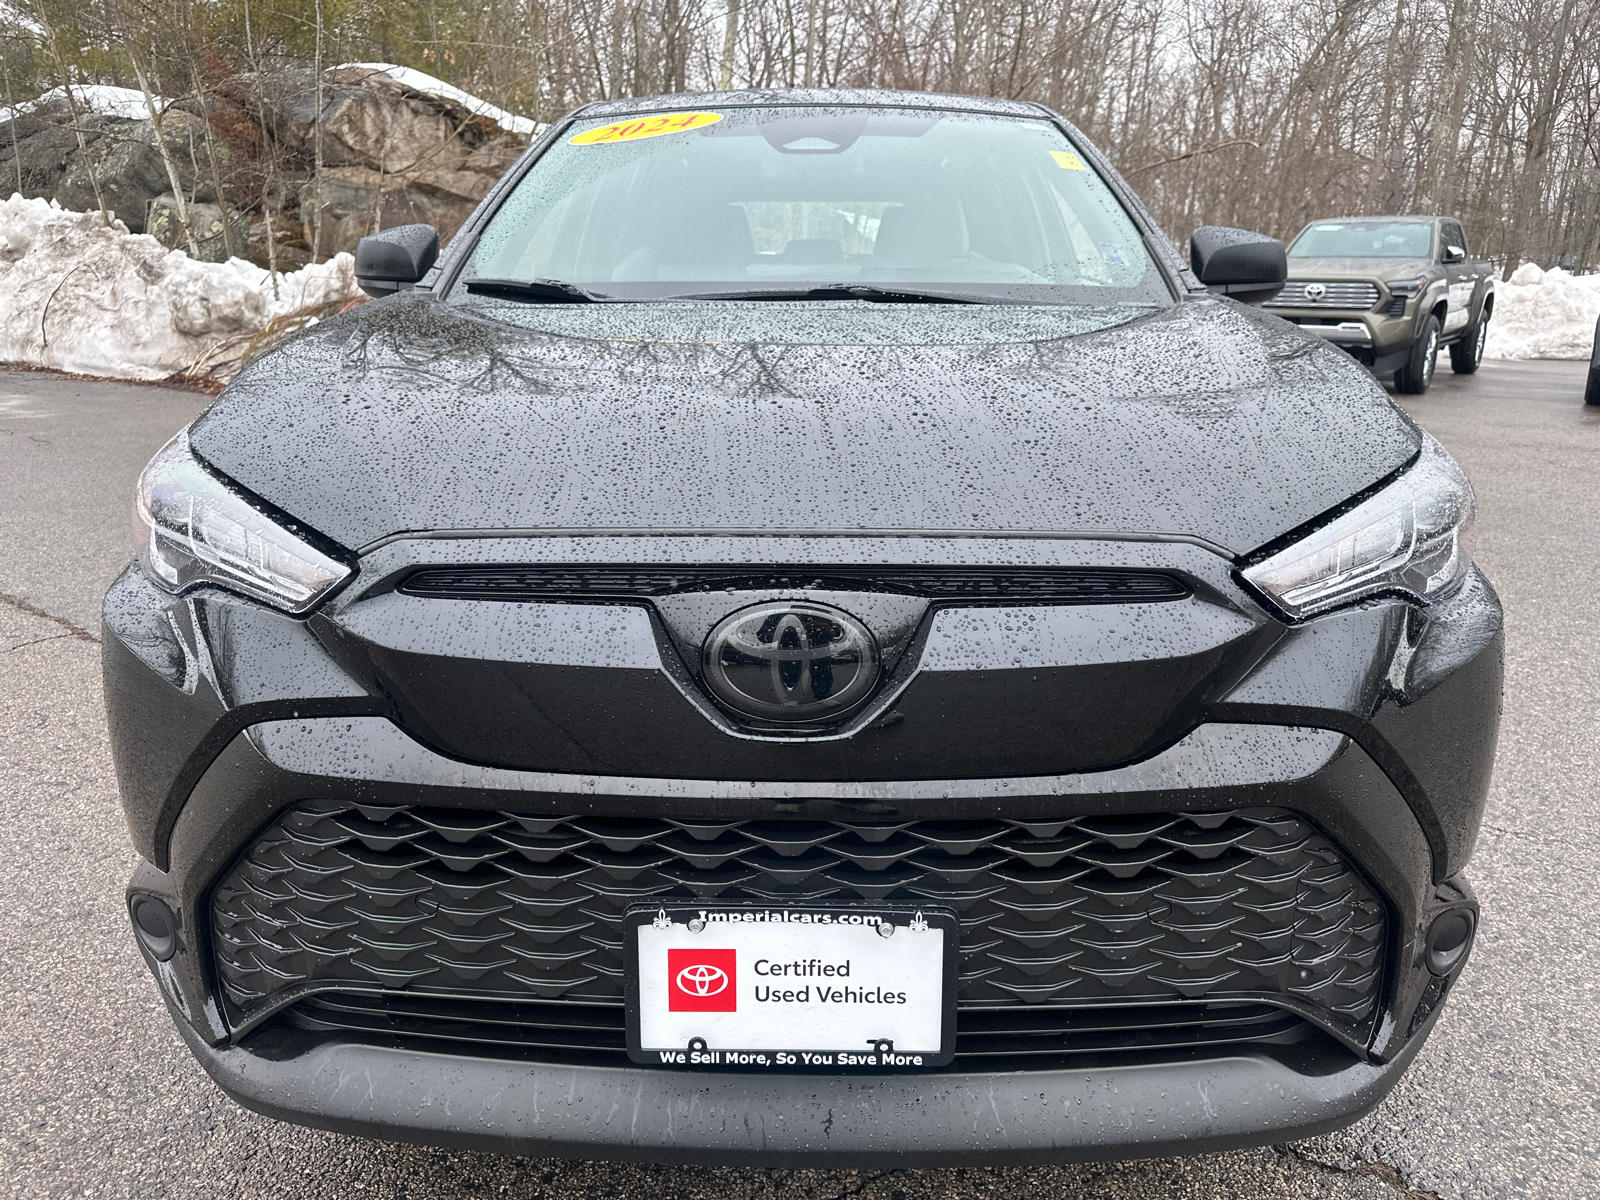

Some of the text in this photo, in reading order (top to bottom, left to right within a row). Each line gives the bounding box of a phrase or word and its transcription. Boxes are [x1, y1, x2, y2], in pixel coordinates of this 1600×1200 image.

[594, 114, 700, 142] 2024
[698, 911, 882, 926] Imperialcars.com
[754, 959, 850, 977] Certified
[755, 985, 907, 1004] Used Vehicles
[660, 1052, 923, 1066] We Sell More, So You Save More
